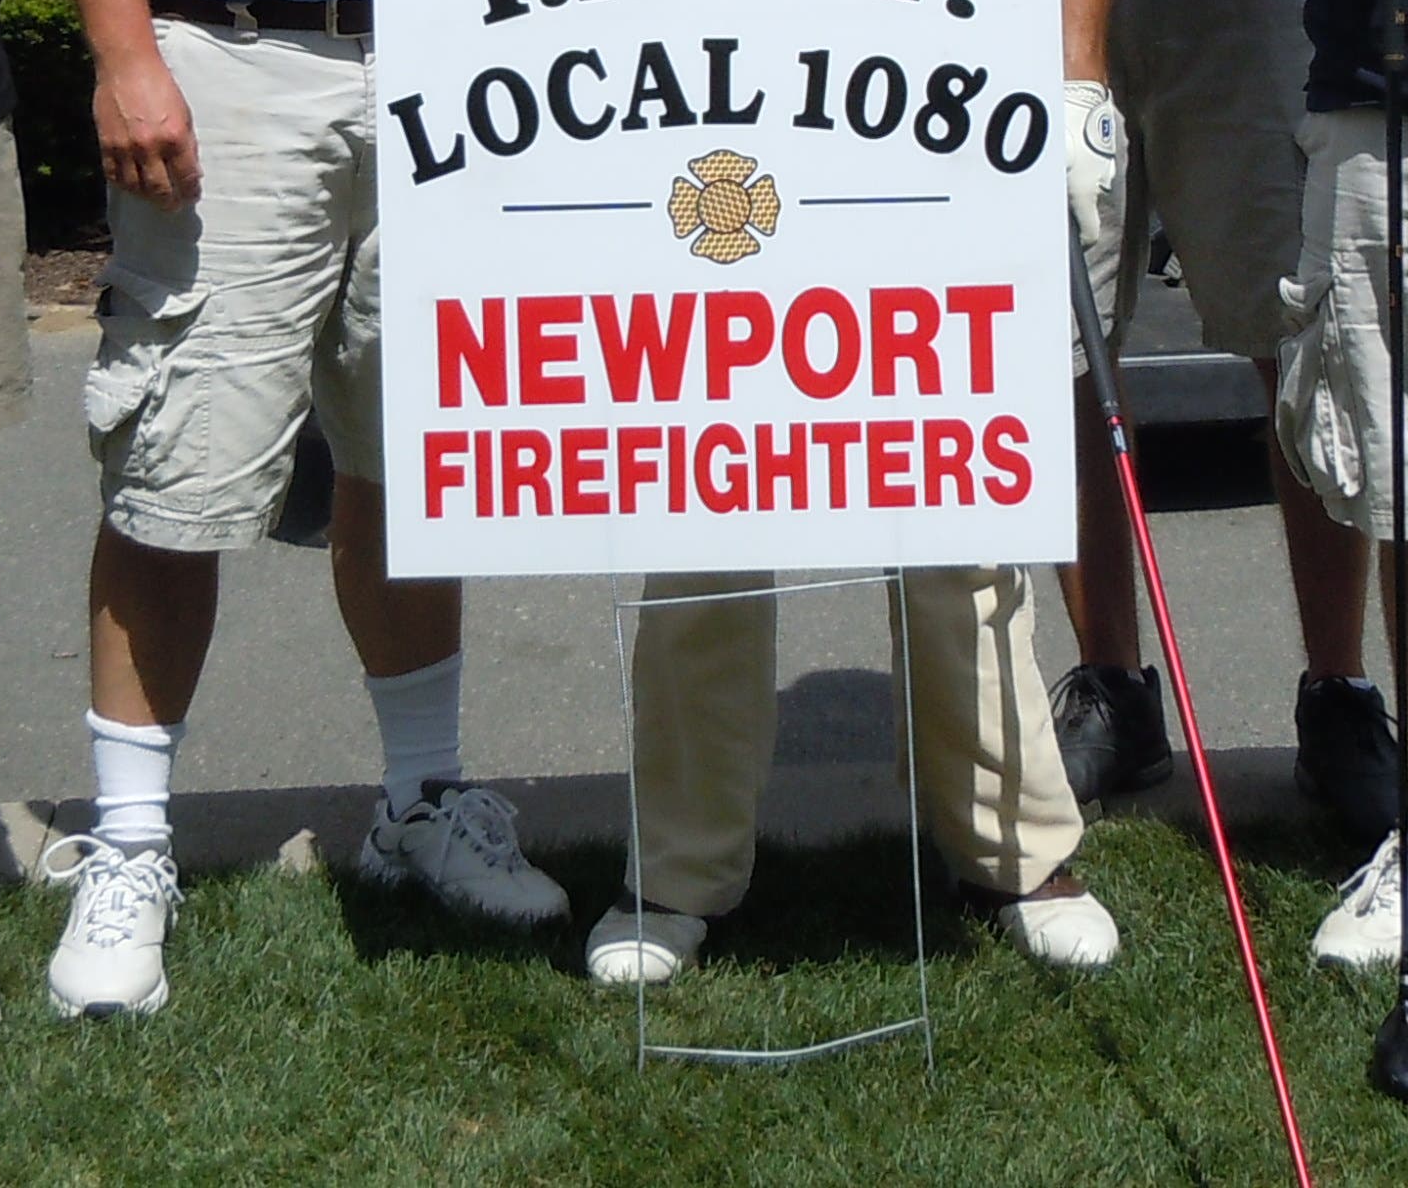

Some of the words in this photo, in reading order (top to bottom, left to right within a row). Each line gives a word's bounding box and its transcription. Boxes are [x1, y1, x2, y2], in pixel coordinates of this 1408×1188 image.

[389, 39, 763, 184] LOCAL
[794, 51, 1047, 173] 1080
[437, 285, 1014, 407] NEWPORT
[425, 416, 1032, 518] FIREFIGHTERS
